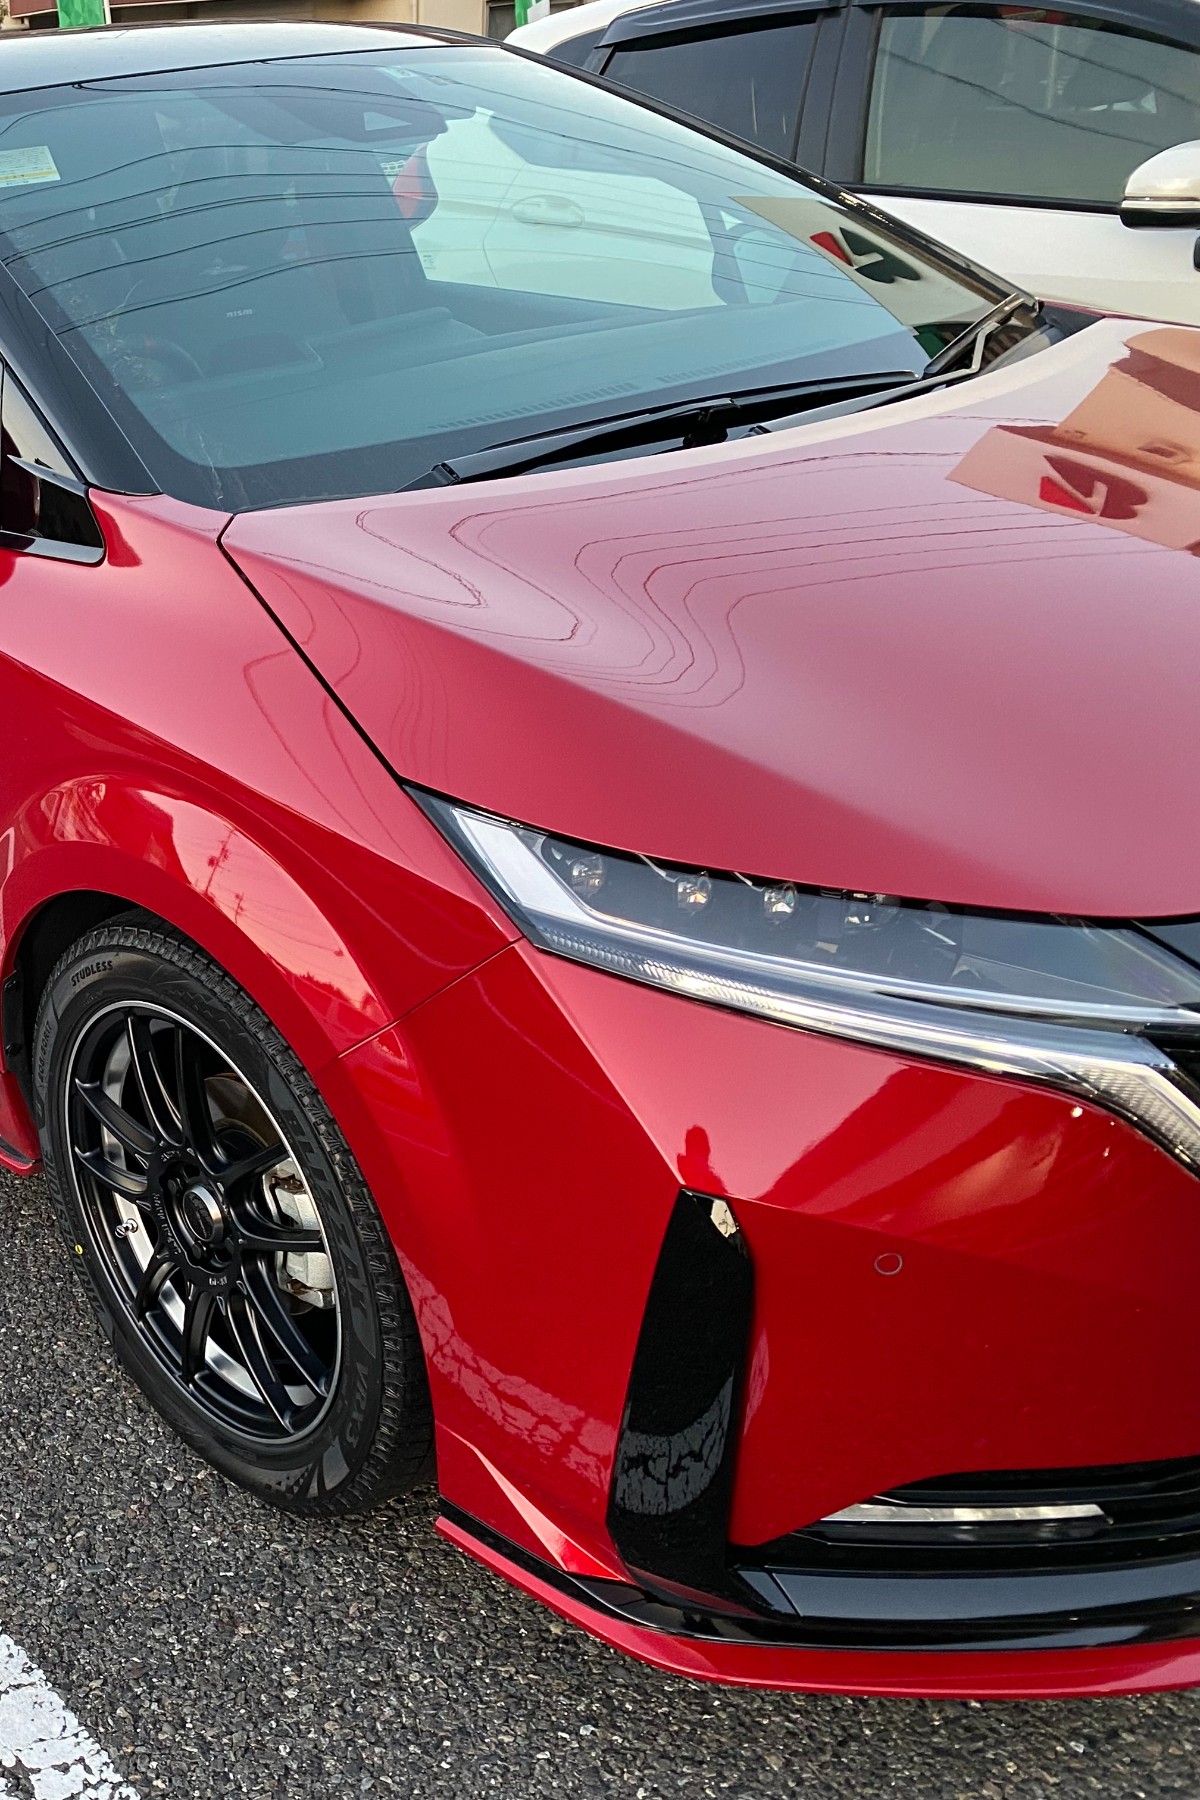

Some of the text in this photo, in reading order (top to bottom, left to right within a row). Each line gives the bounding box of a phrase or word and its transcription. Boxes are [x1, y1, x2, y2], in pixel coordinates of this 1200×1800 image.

[70, 959, 114, 987] STUDLESS
[42, 1147, 106, 1313] BRIDGESTONE
[280, 1108, 367, 1319] BLIZZAK
